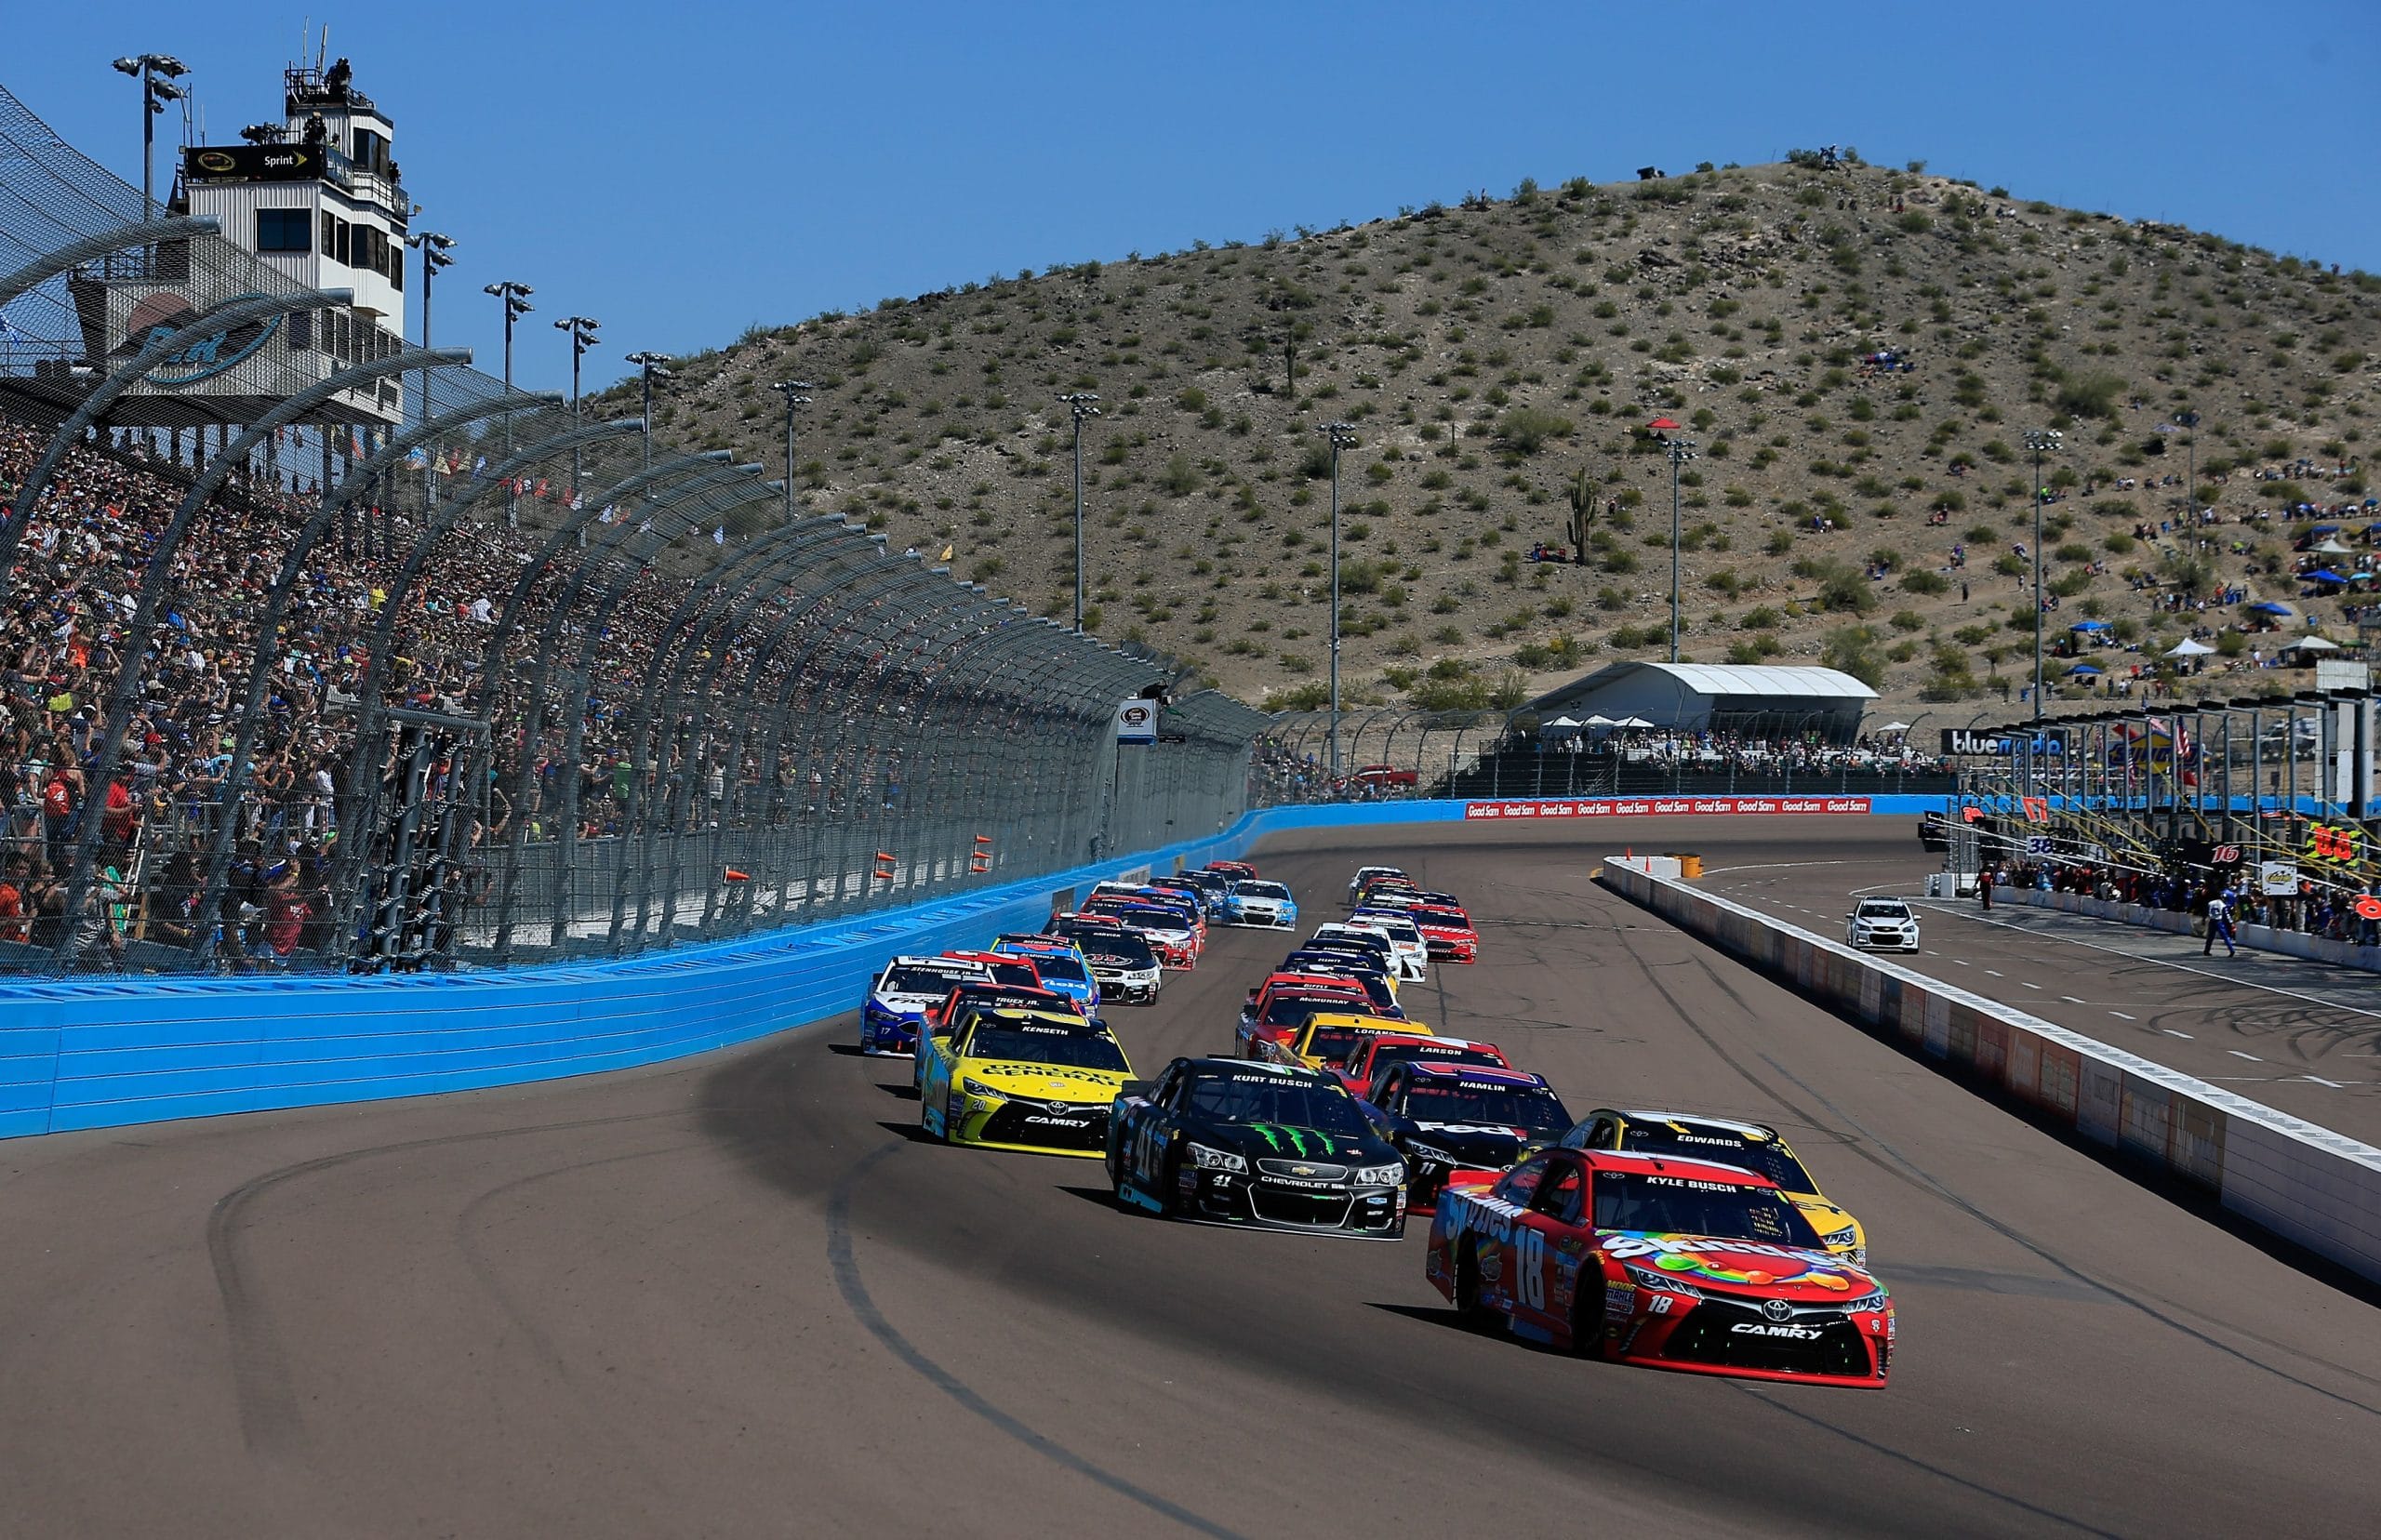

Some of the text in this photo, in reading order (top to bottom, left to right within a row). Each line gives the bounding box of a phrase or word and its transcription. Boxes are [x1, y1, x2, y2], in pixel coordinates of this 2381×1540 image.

[264, 155, 294, 168] Sprint
[1469, 800, 1867, 816] Good Sam Good Sam Good Sam Good Sam Good Sam Good Sam Good Sam Good Sam Good Sam Good Sam
[2029, 838, 2054, 854] 38
[2211, 844, 2241, 863] 16
[911, 967, 960, 976] STENHOUSE
[1299, 996, 1350, 1005] McMURRAY
[881, 1027, 891, 1035] 17
[1022, 1026, 1069, 1036] KENSETH
[1419, 1046, 1463, 1055] LARSON
[1232, 1074, 1312, 1088] KURT BUSCH
[1459, 1081, 1506, 1092] HAMLIN
[970, 1099, 987, 1110] 20
[1024, 1115, 1091, 1128] CAMRY
[1677, 1135, 1742, 1148] EDWARDS
[1419, 1162, 1437, 1175] 11
[1212, 1175, 1231, 1188] 41
[1260, 1175, 1329, 1189] CHEVROLET
[1646, 1176, 1737, 1193] KYLE BUSCH
[1515, 1225, 1545, 1310] 18
[1606, 1280, 1637, 1292] MOOG
[1647, 1294, 1674, 1314] 18
[1730, 1323, 1823, 1340] CAMRY
